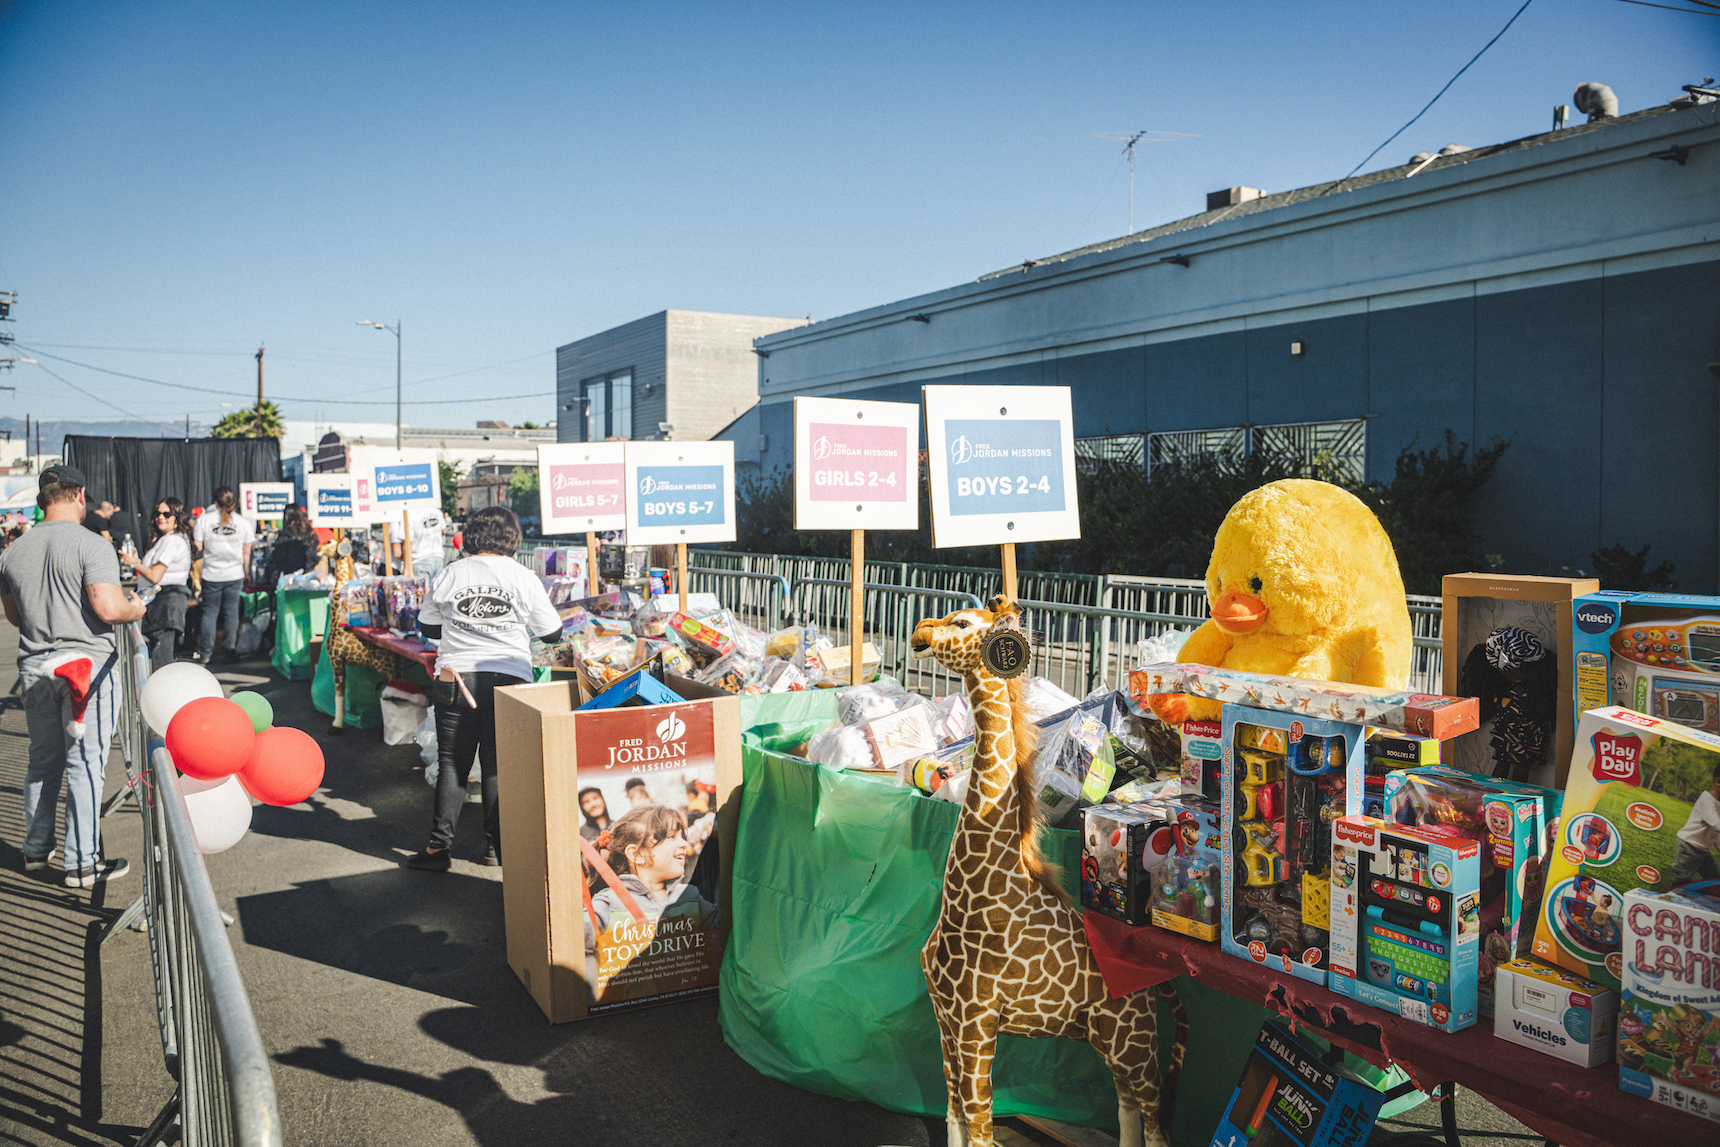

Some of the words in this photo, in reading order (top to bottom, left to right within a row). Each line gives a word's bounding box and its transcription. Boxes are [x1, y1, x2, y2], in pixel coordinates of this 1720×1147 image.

[831, 447, 862, 456] JORDAN
[864, 449, 898, 458] MISSIONS
[972, 448, 1009, 458] JORDAN
[1012, 448, 1052, 458] MISSIONS
[814, 470, 864, 487] GIRLS
[868, 471, 897, 487] 2-4
[957, 476, 1013, 496] BOYS
[1016, 475, 1050, 494] 2-4
[378, 486, 404, 496] BOYS
[406, 484, 429, 494] 8-10
[556, 495, 595, 508] GIRLS
[597, 494, 618, 506] 5-7
[644, 502, 686, 515] BOYS
[689, 501, 714, 514] 5-7
[318, 504, 340, 513] BOYS
[454, 586, 514, 602] GALPIN
[1578, 612, 1612, 624] vtech
[619, 738, 643, 748] FRED
[1600, 740, 1635, 760] Play
[605, 742, 687, 769] JORDAN
[1387, 750, 1408, 759] TATTOOS
[632, 760, 687, 773] MISSIONS
[1601, 756, 1635, 776] Day
[1634, 806, 1657, 818] Realistic
[1636, 813, 1653, 822] Sports
[1337, 824, 1374, 840] fisher-price
[1489, 834, 1494, 844] 2
[1428, 898, 1439, 910] fp
[613, 916, 695, 943] Christmas
[602, 943, 645, 962] TOY
[648, 933, 705, 956] DRIVE
[1332, 942, 1346, 952] 55+
[1537, 945, 1547, 954] 2+
[1359, 990, 1373, 1000] Let's
[1374, 995, 1399, 1009] Connect
[1636, 984, 1670, 1000] Kingdom
[1683, 995, 1708, 1003] Sweet
[1432, 1008, 1446, 1017] 6-36
[1513, 1019, 1566, 1046] Vehicles
[1259, 1029, 1296, 1066] T-BALL
[1298, 1060, 1321, 1084] SET
[1277, 1098, 1303, 1126] BALL
[1328, 1104, 1355, 1146] BALL
[1342, 1100, 1371, 1147] JUN
